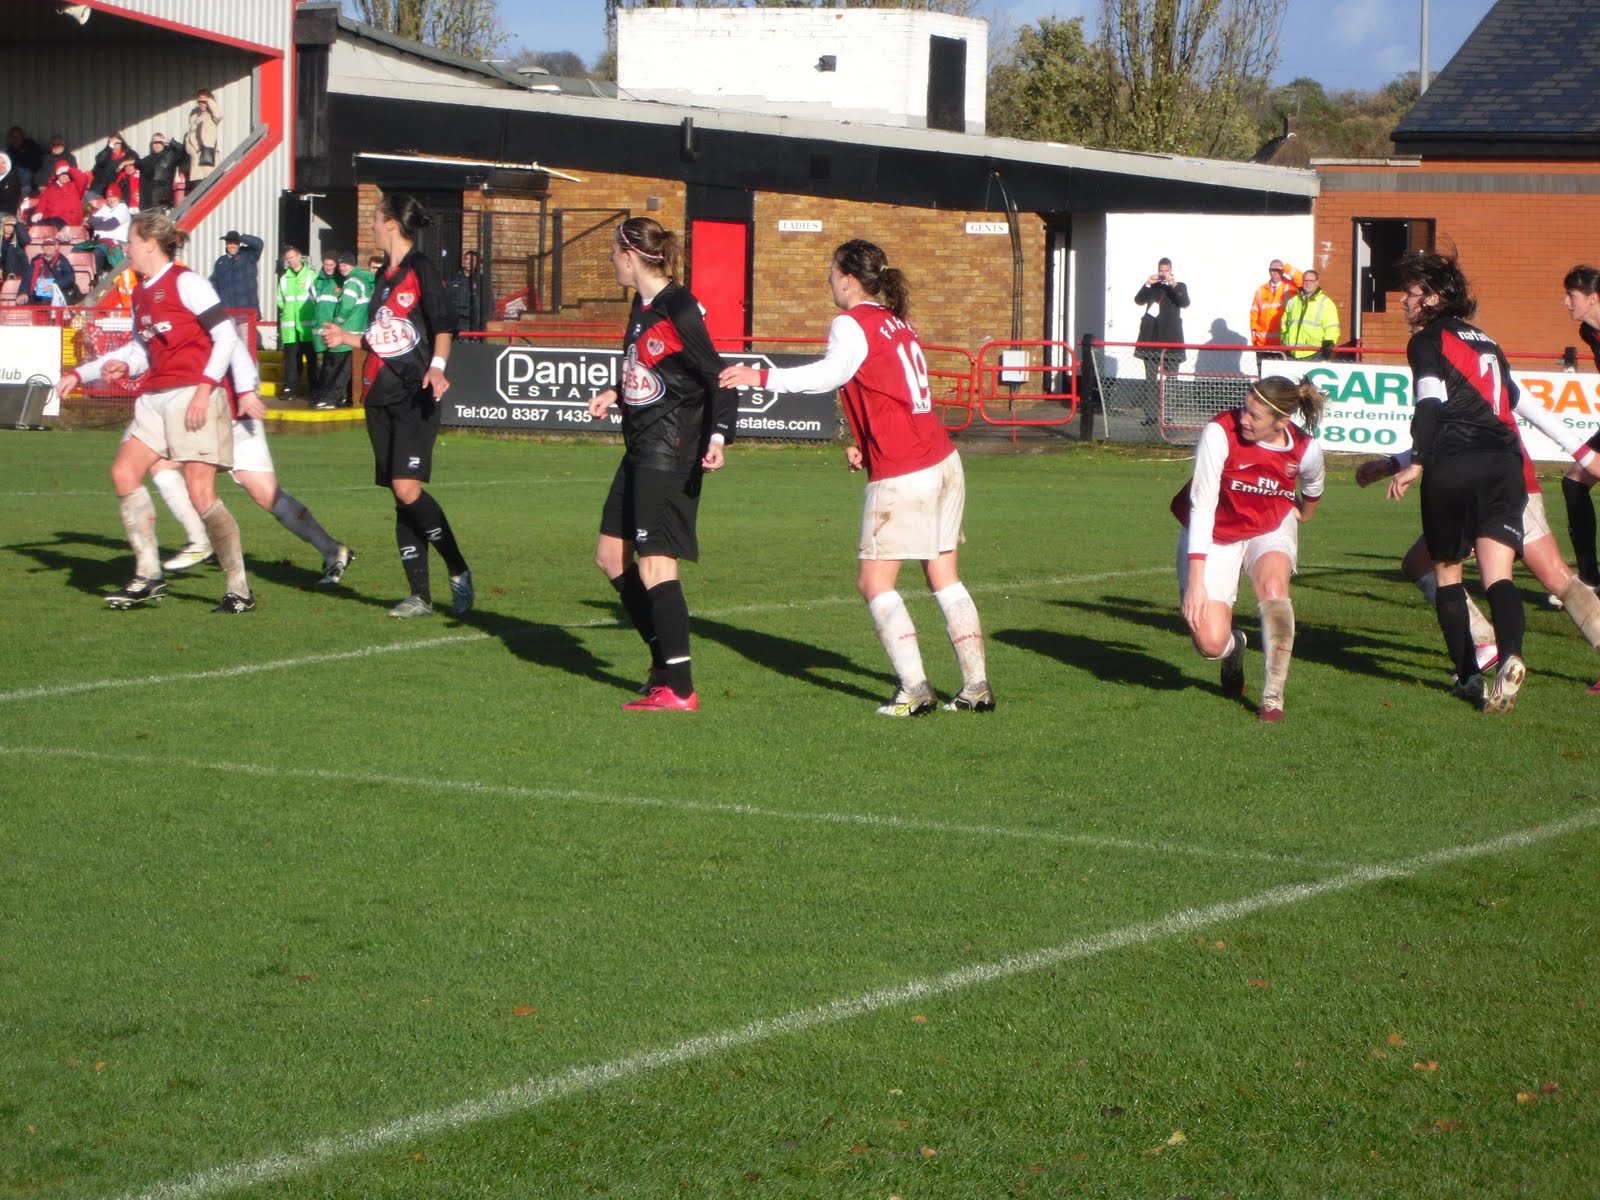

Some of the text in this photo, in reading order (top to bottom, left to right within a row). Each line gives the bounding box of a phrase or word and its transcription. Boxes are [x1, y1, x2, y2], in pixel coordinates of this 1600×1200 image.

[783, 221, 818, 230] LADIES
[971, 224, 1004, 232] GENTS
[0, 368, 22, 380] lub
[508, 353, 617, 386] Daniel
[508, 385, 600, 398] ESTAT
[1303, 368, 1416, 407] GAR
[1521, 378, 1600, 415] BA
[455, 405, 592, 423] Tel:020 8387 1435
[736, 417, 821, 431] states.com
[1258, 477, 1279, 490] Fly
